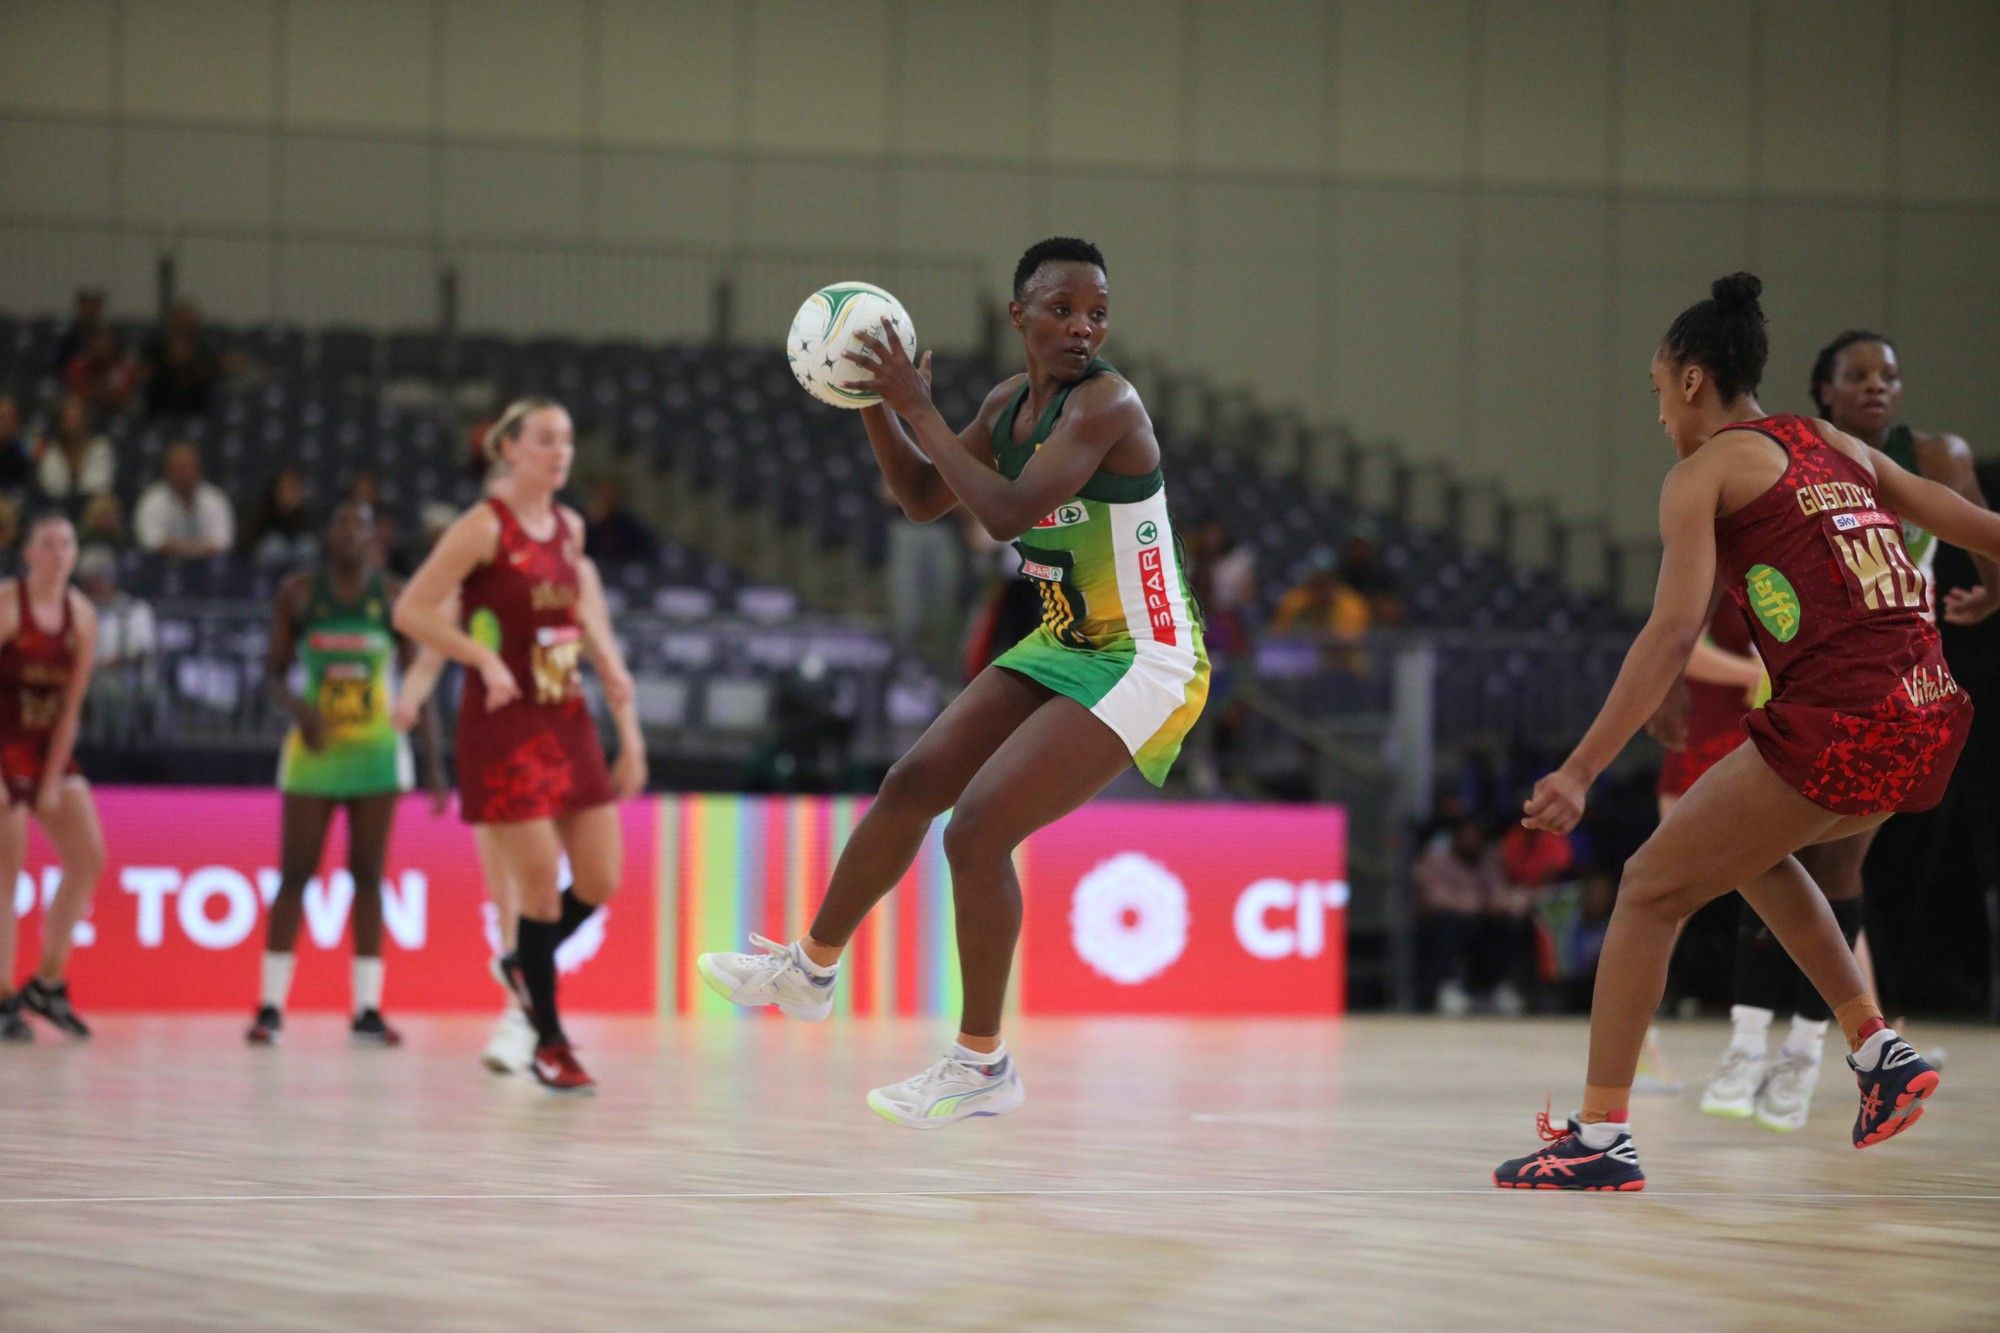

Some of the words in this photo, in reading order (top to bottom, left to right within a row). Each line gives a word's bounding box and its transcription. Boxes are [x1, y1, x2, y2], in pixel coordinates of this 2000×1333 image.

[1837, 516, 1856, 528] sky
[1142, 550, 1171, 628] SPAR
[1833, 528, 1922, 610] WD
[119, 864, 428, 949] TOWN
